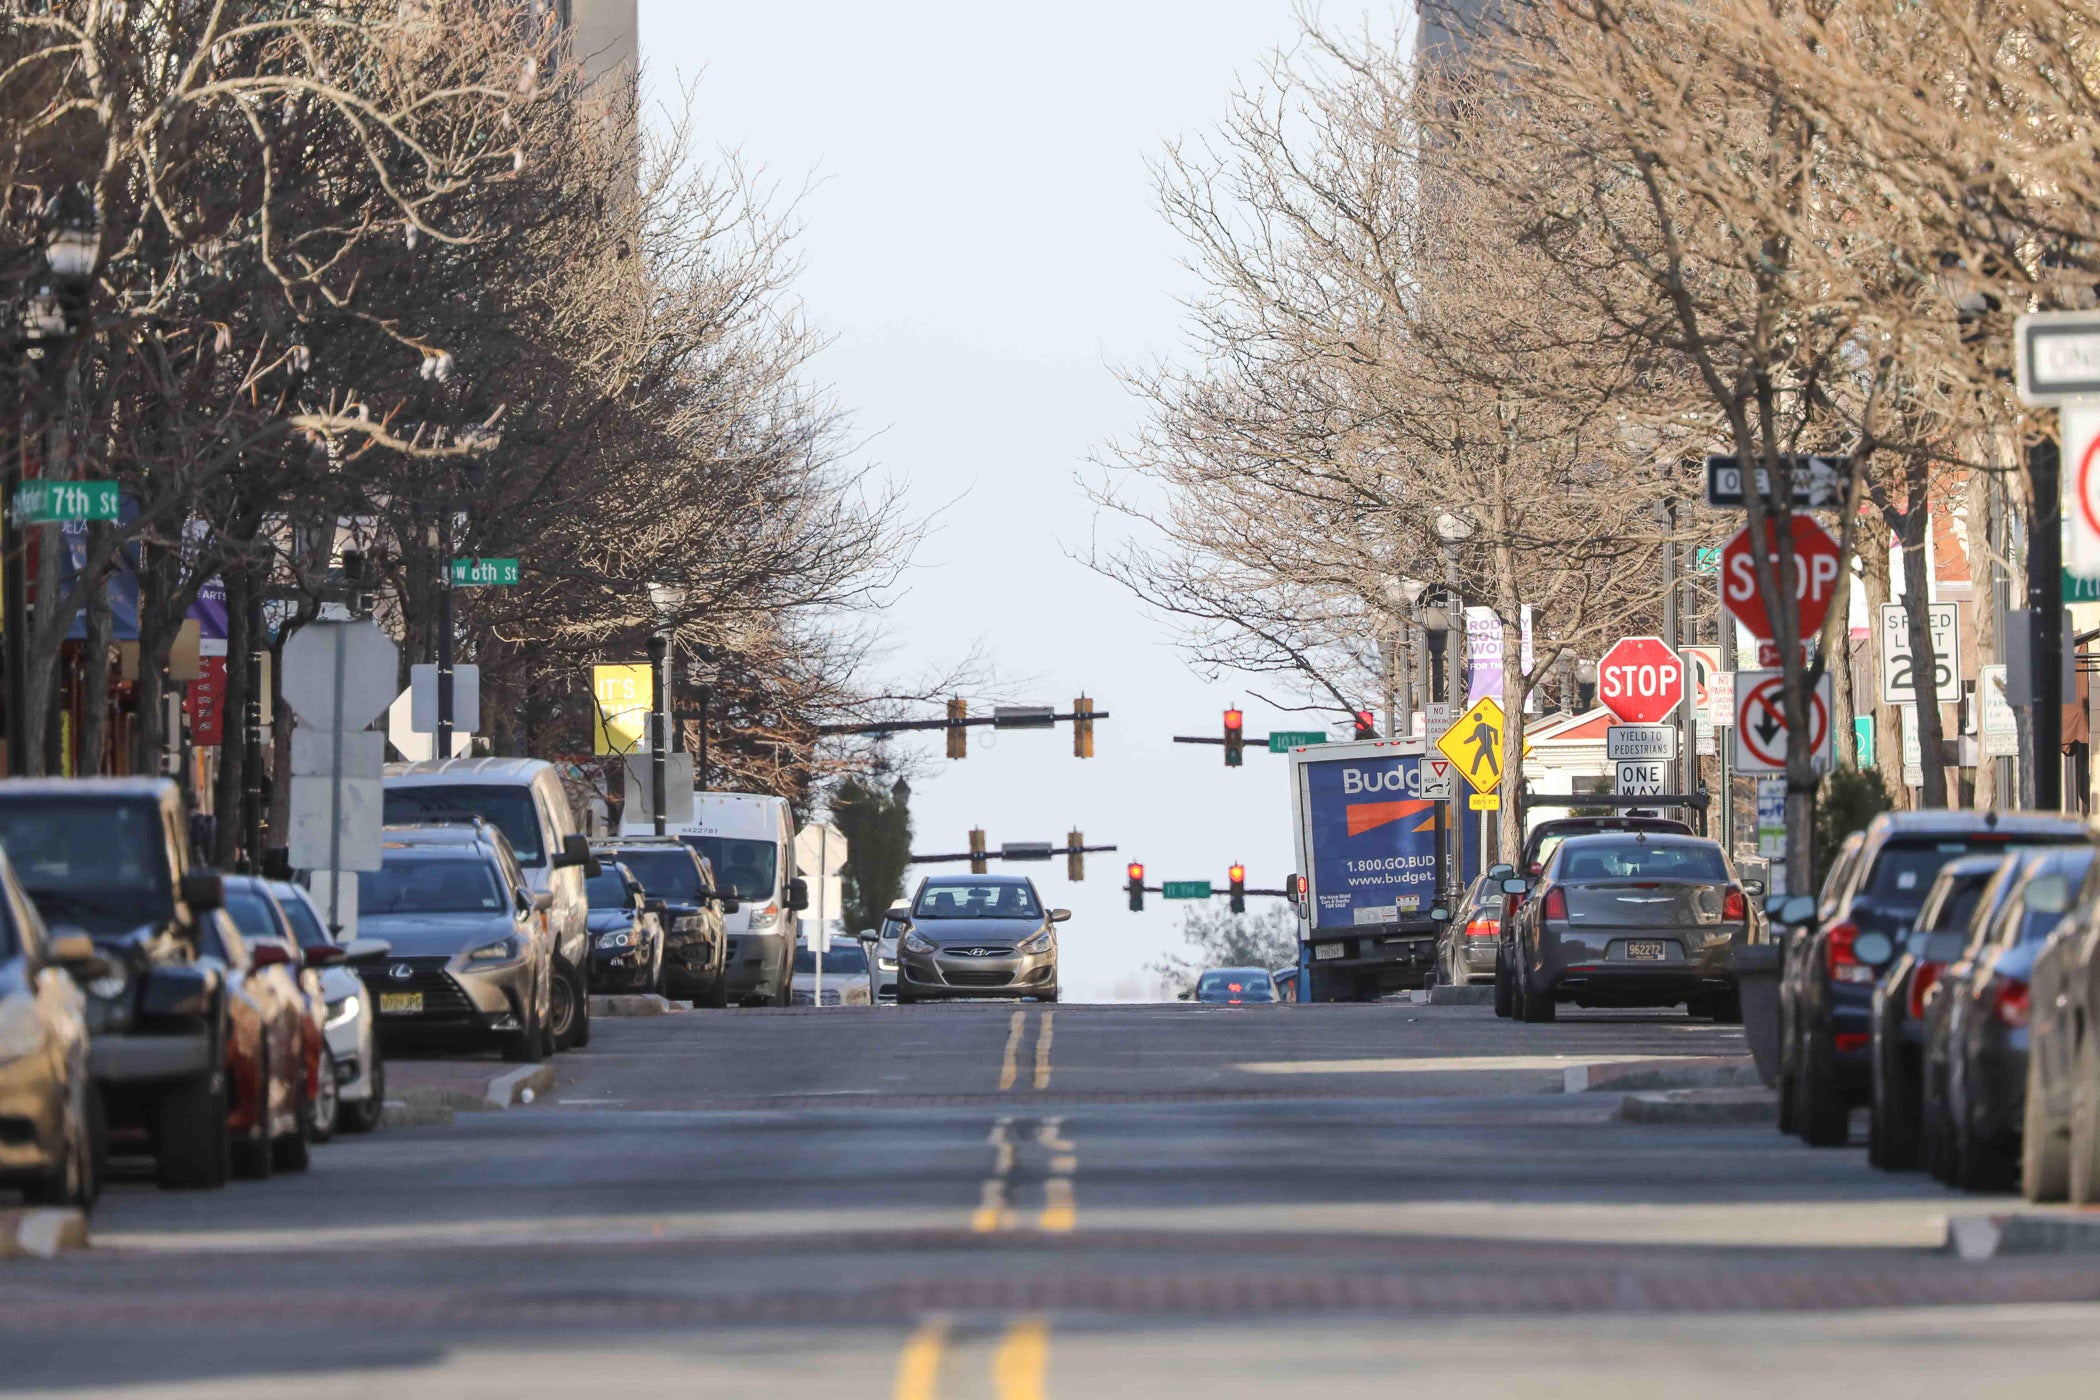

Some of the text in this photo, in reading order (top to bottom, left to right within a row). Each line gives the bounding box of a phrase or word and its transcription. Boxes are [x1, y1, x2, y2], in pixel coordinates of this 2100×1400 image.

[52, 486, 90, 515] 7th
[100, 491, 118, 514] St
[456, 566, 467, 580] W
[504, 566, 518, 581] St
[1888, 613, 1951, 629] SPED
[1469, 662, 1488, 670] FOR
[1890, 654, 1952, 689] 25
[1603, 664, 1678, 698] STOP
[599, 678, 635, 701] IT'S
[1433, 707, 1444, 715] NO
[1619, 731, 1662, 742] YIELD TO
[1614, 744, 1668, 755] PEDESTRIANS
[1342, 764, 1420, 798] Budg
[1622, 766, 1660, 783] ONE
